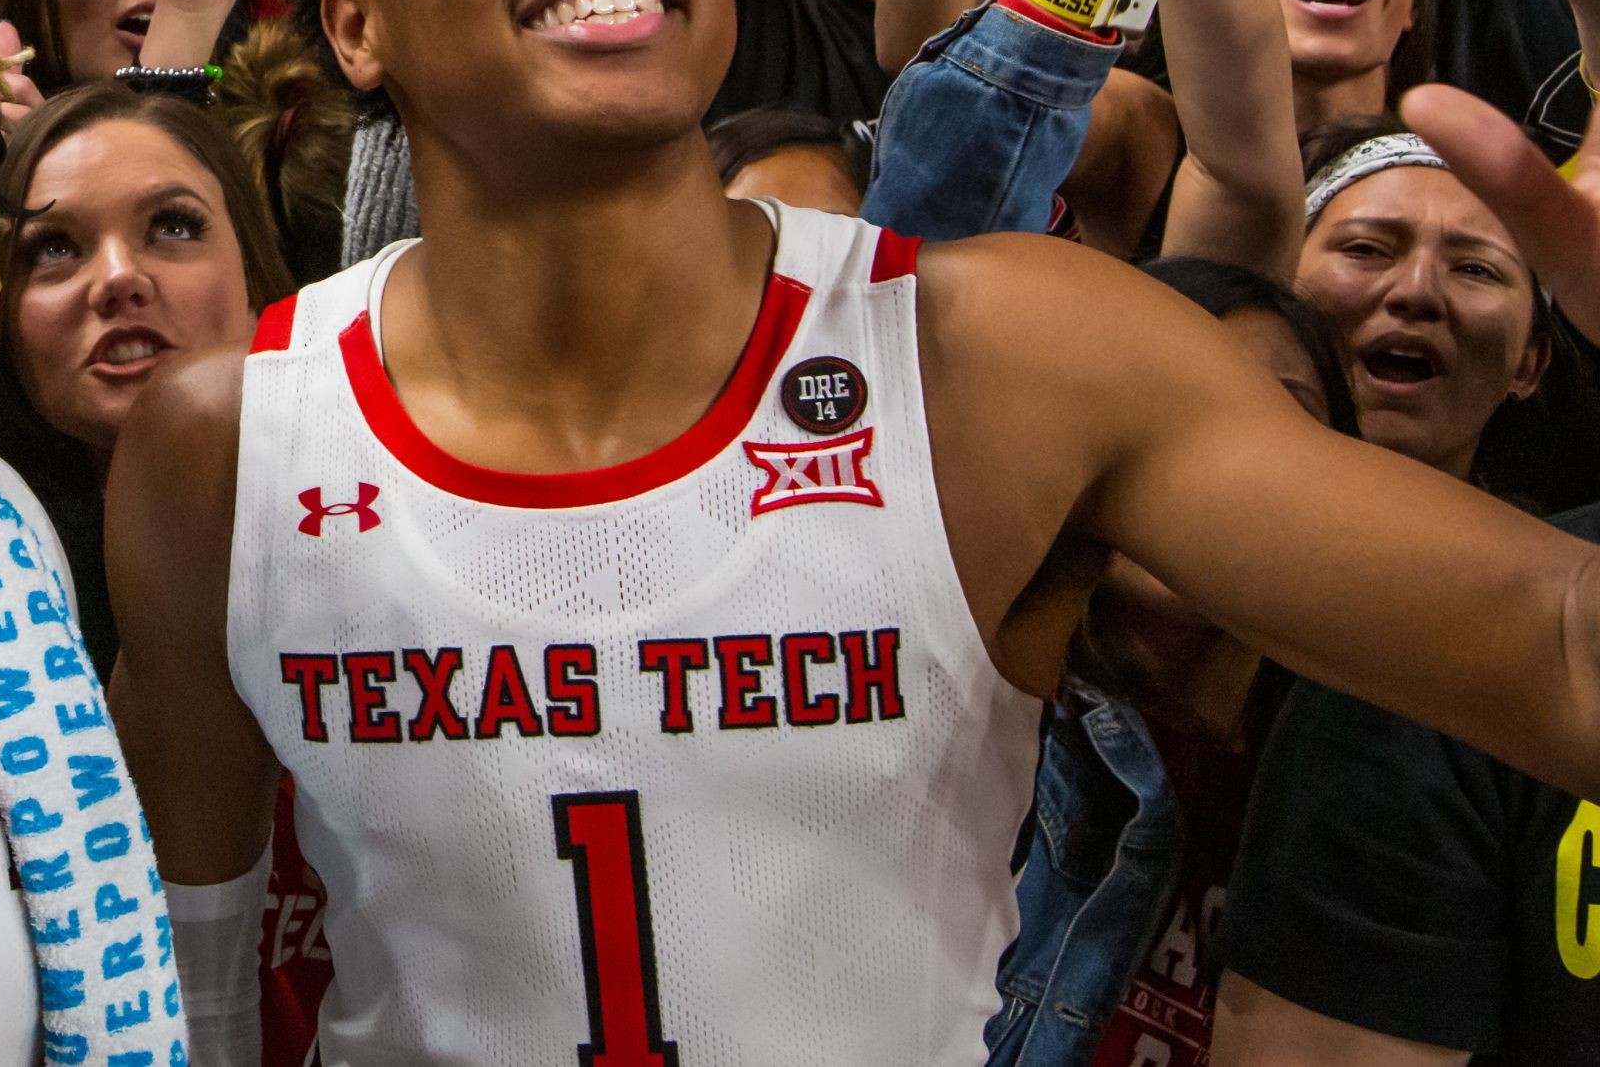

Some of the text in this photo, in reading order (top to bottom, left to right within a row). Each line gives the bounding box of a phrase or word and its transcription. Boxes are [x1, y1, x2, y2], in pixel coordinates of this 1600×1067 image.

[798, 372, 850, 401] DRE
[815, 401, 837, 421] 14
[280, 628, 907, 744] TEXAS TECH
[552, 790, 678, 1067] 1
